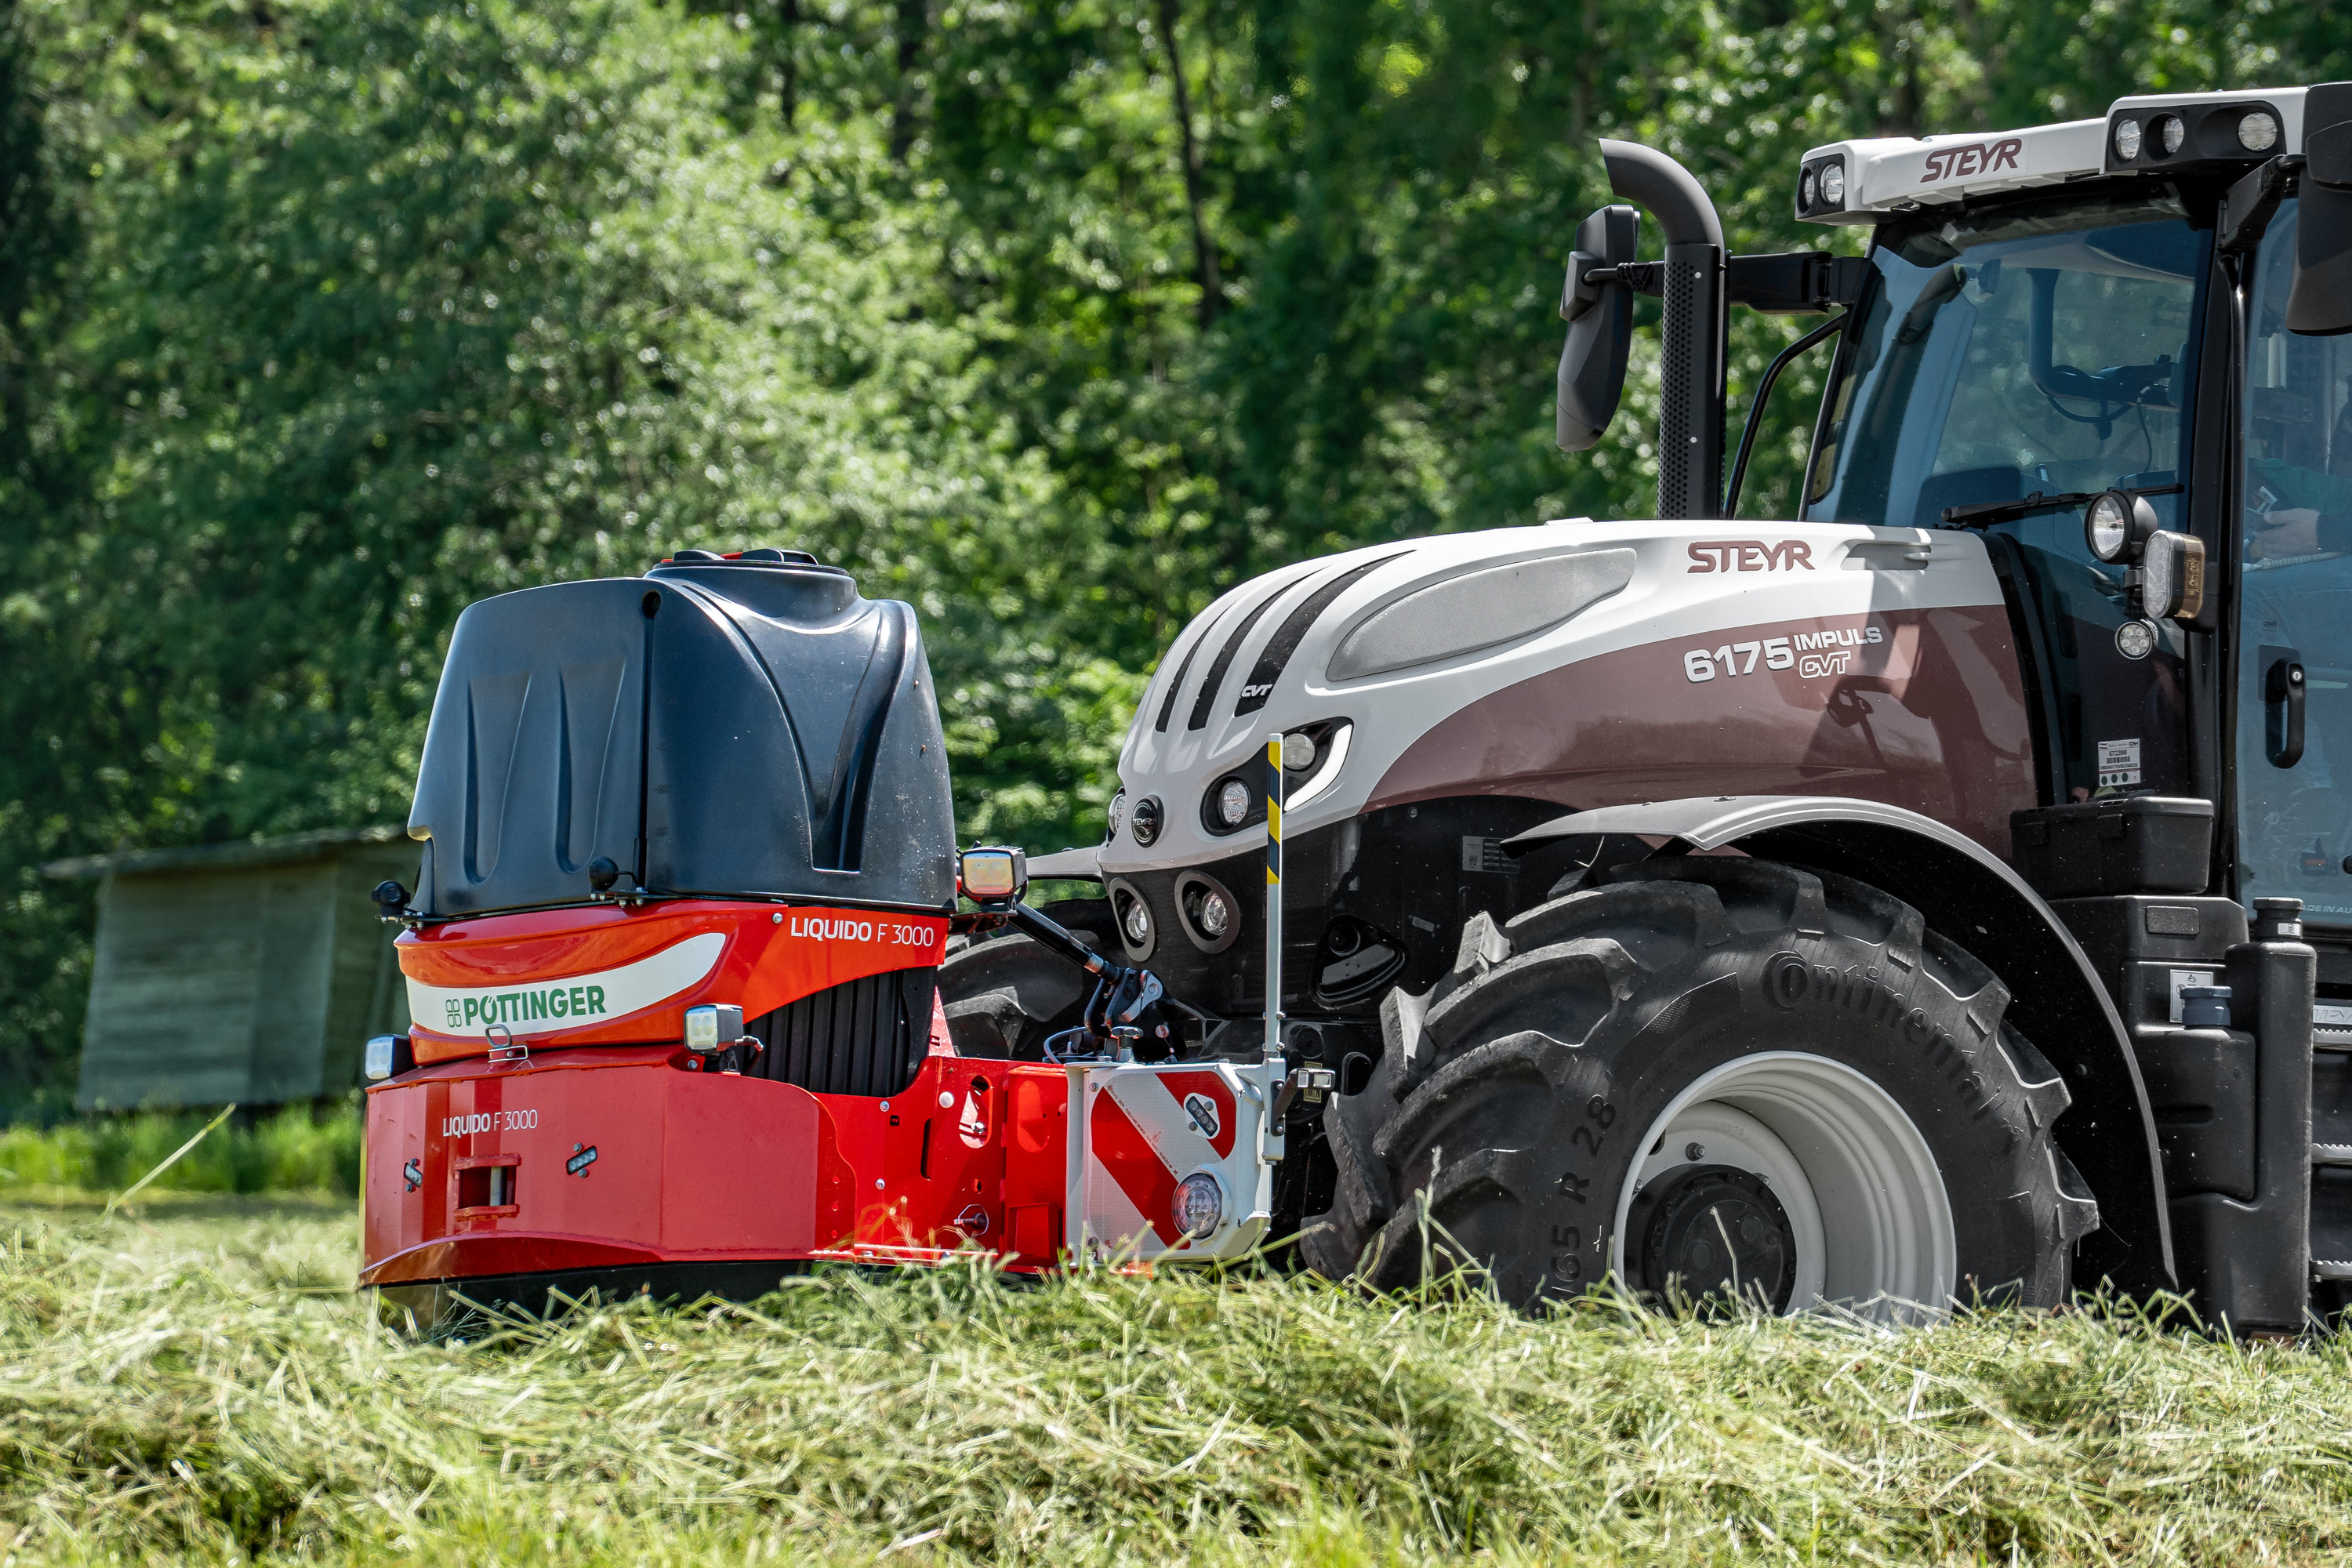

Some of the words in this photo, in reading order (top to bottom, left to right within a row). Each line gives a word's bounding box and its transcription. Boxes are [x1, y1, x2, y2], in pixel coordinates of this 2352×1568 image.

[1920, 138, 2022, 183] STEYR
[1687, 539, 1816, 574] STEYR
[1683, 637, 1795, 683] 6175
[1794, 626, 1883, 651] IMPULS
[1798, 651, 1852, 680] CVT
[1241, 684, 1273, 697] CVT
[790, 916, 873, 942] LIQUIDO
[877, 923, 887, 943] F
[891, 924, 935, 947] 3000
[464, 985, 606, 1027] PÖTTINGER
[442, 1112, 492, 1137] LIQUIDO
[494, 1111, 501, 1131] F
[505, 1109, 539, 1131] 3000
[1571, 1094, 1617, 1159] 28
[1560, 1172, 1591, 1204] R
